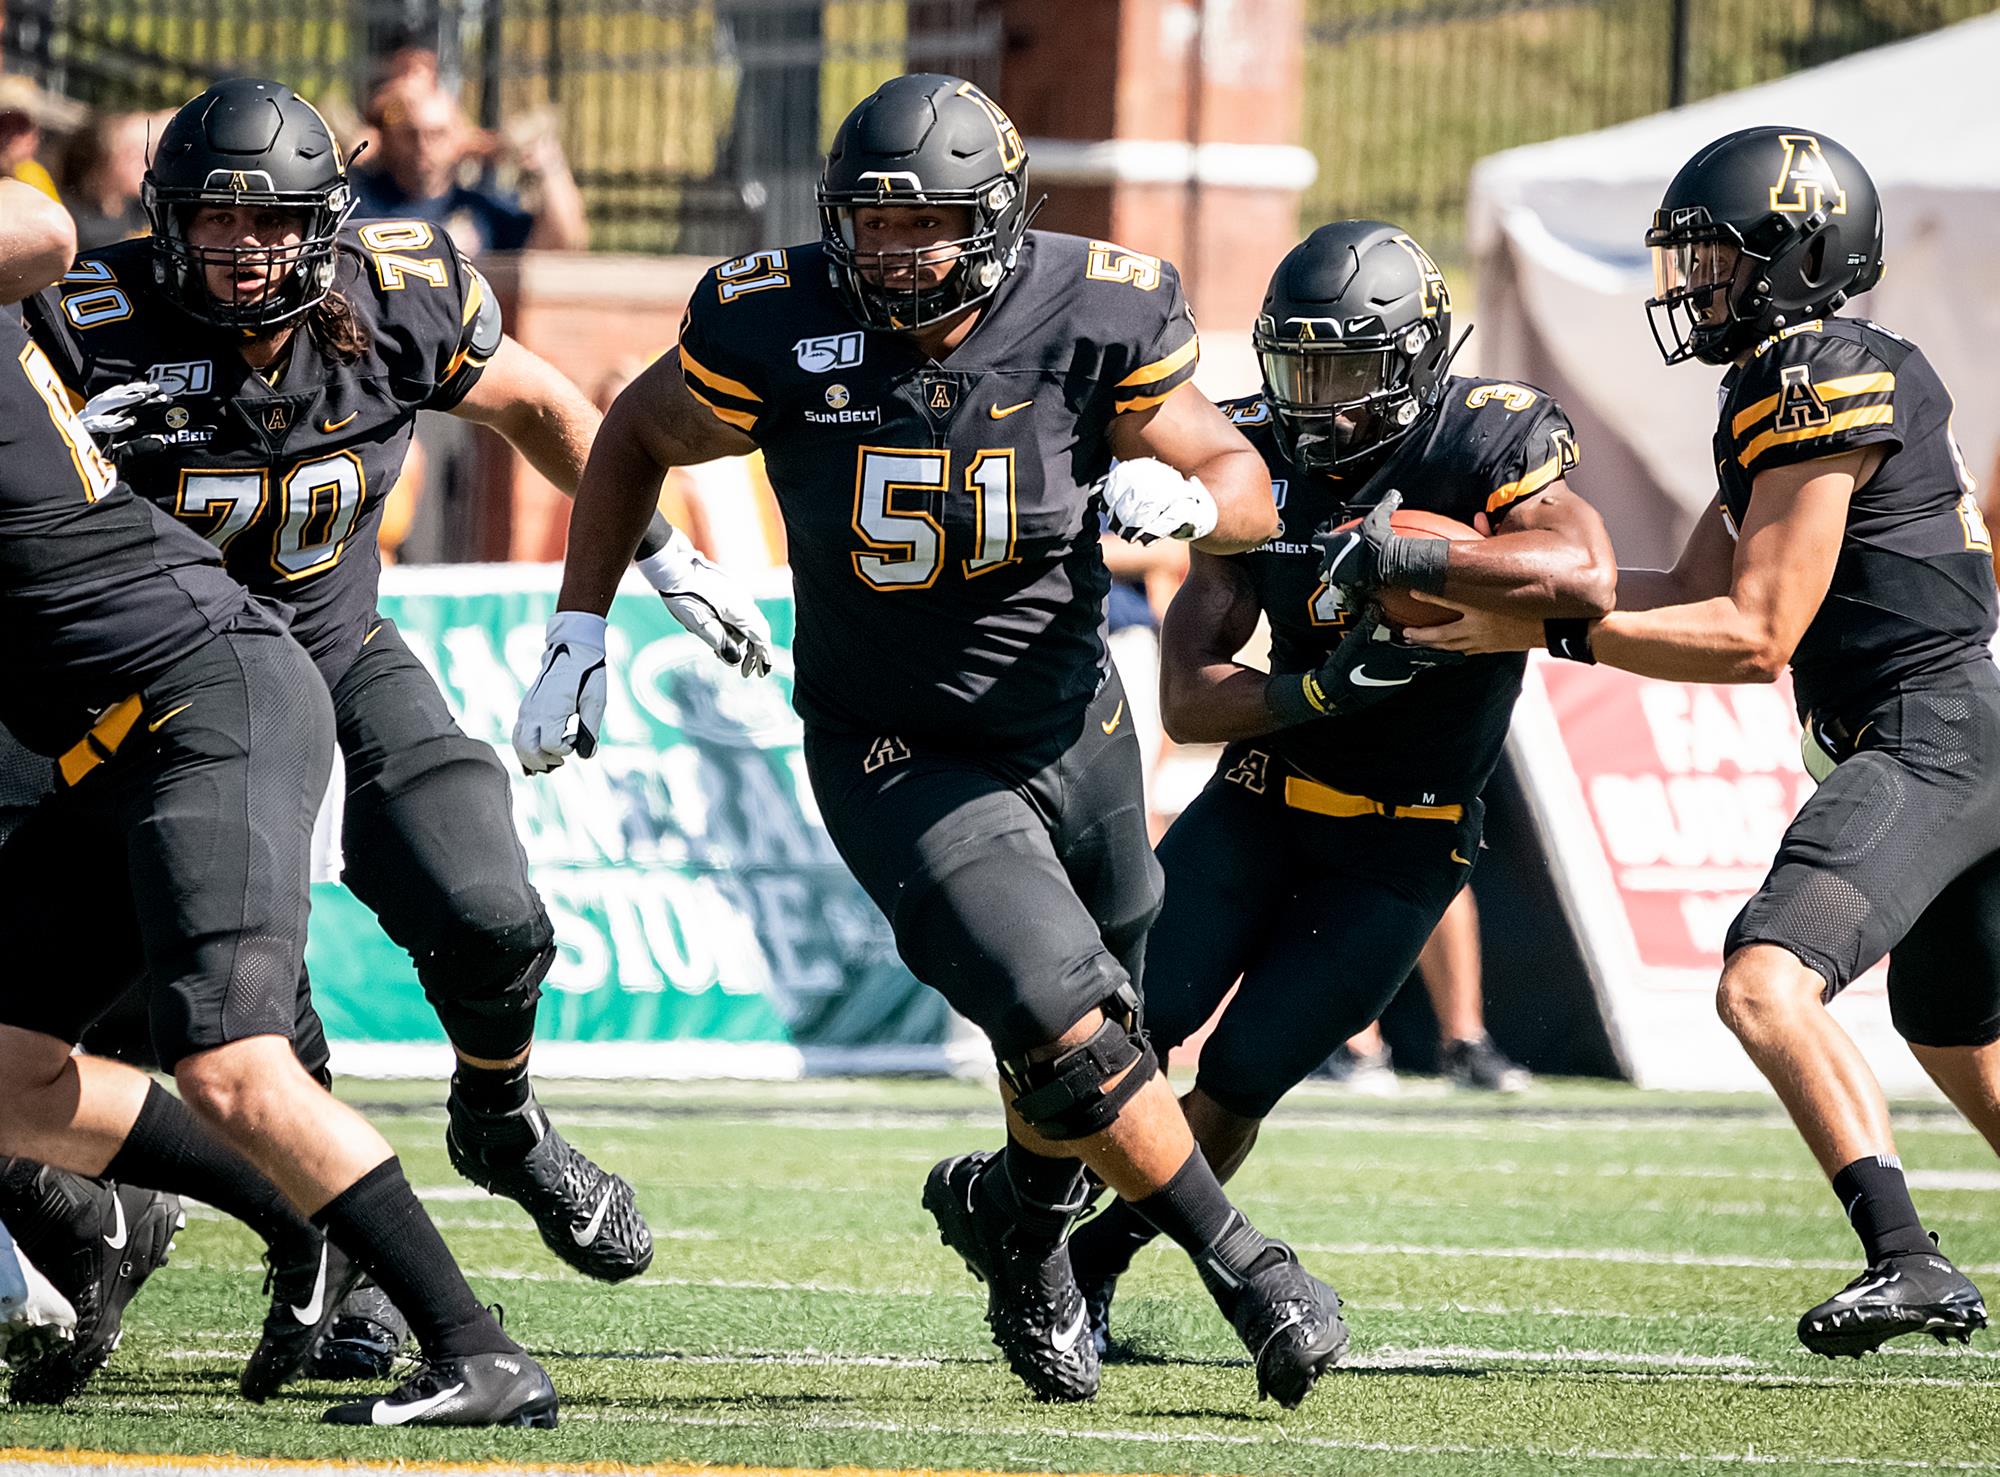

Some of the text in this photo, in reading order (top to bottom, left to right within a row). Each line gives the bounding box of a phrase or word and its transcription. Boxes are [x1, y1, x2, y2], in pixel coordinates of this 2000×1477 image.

[1769, 134, 1847, 215] A
[358, 221, 449, 291] 70
[716, 248, 791, 305] 51
[51, 260, 134, 330] 70
[791, 330, 865, 374] 150
[268, 408, 286, 430] A
[930, 385, 950, 408] A
[1465, 383, 1538, 412] 3
[1775, 364, 1831, 432] A
[174, 449, 367, 582] 70
[851, 445, 1023, 591] 51
[1224, 749, 1270, 795] A
[1422, 792, 1436, 805] M
